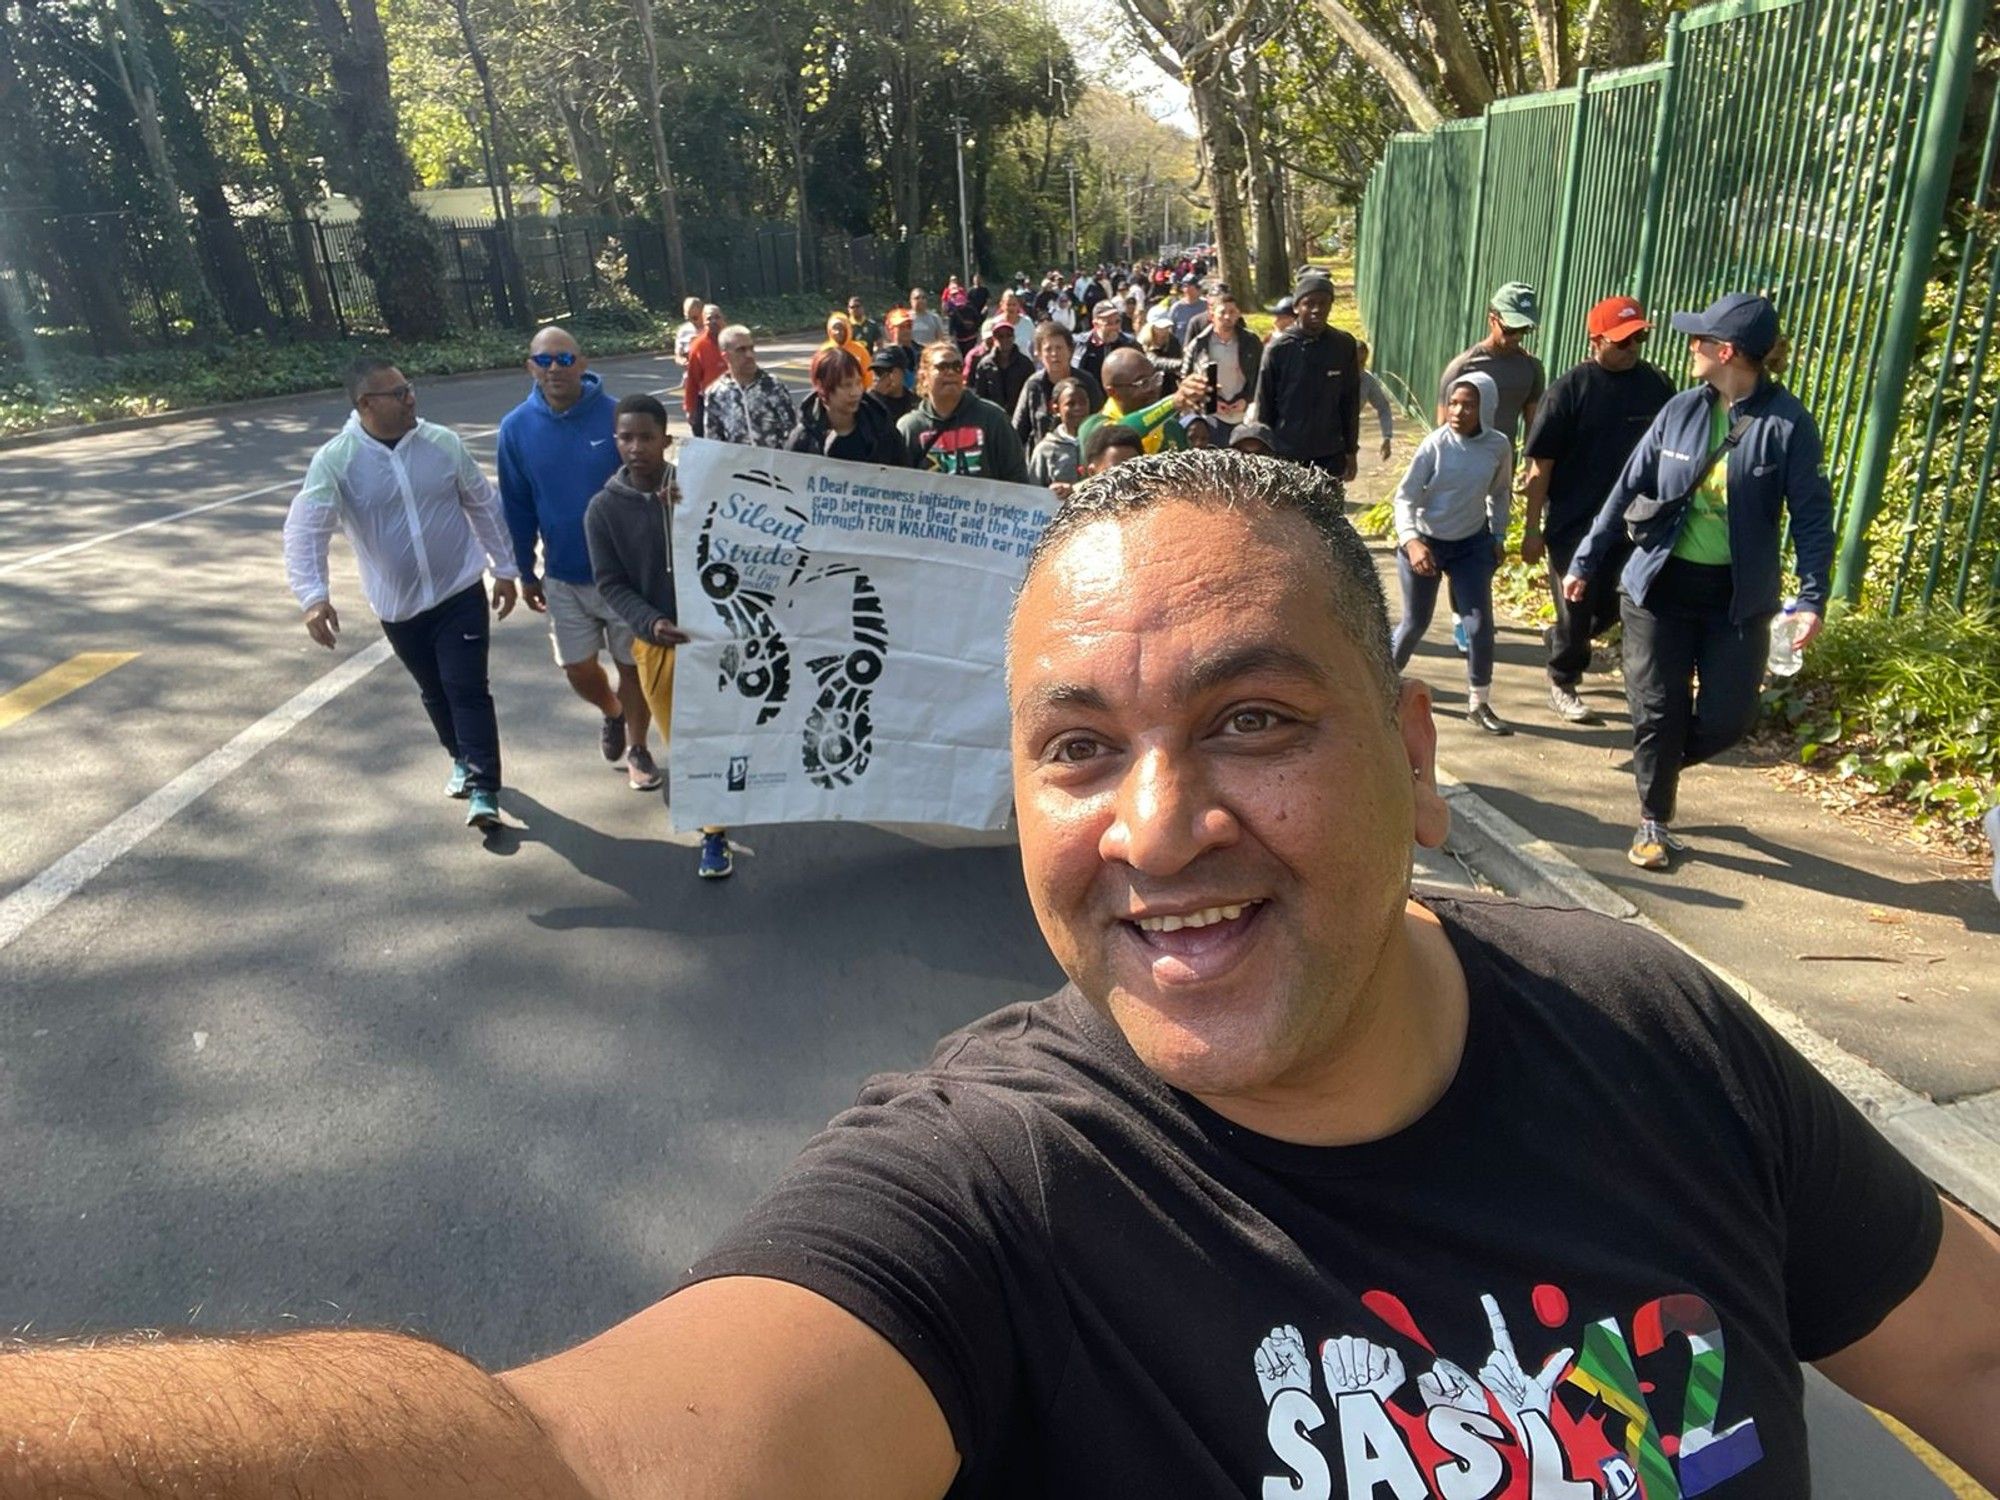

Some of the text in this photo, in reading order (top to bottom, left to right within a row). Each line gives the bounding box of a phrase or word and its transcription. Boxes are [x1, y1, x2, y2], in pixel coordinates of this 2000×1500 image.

[719, 493, 806, 544] Silent
[807, 475, 816, 493] A
[820, 476, 849, 495] Deaf
[852, 484, 916, 504] awareness
[919, 490, 971, 511] initiative
[974, 500, 988, 515] to
[990, 503, 1029, 524] bridge
[812, 495, 1042, 542] gap between the Deaf and the hear
[710, 537, 794, 566] Stride
[812, 508, 1035, 558] through FUN WALKING with ear pl
[1261, 1387, 1595, 1500] SASL
